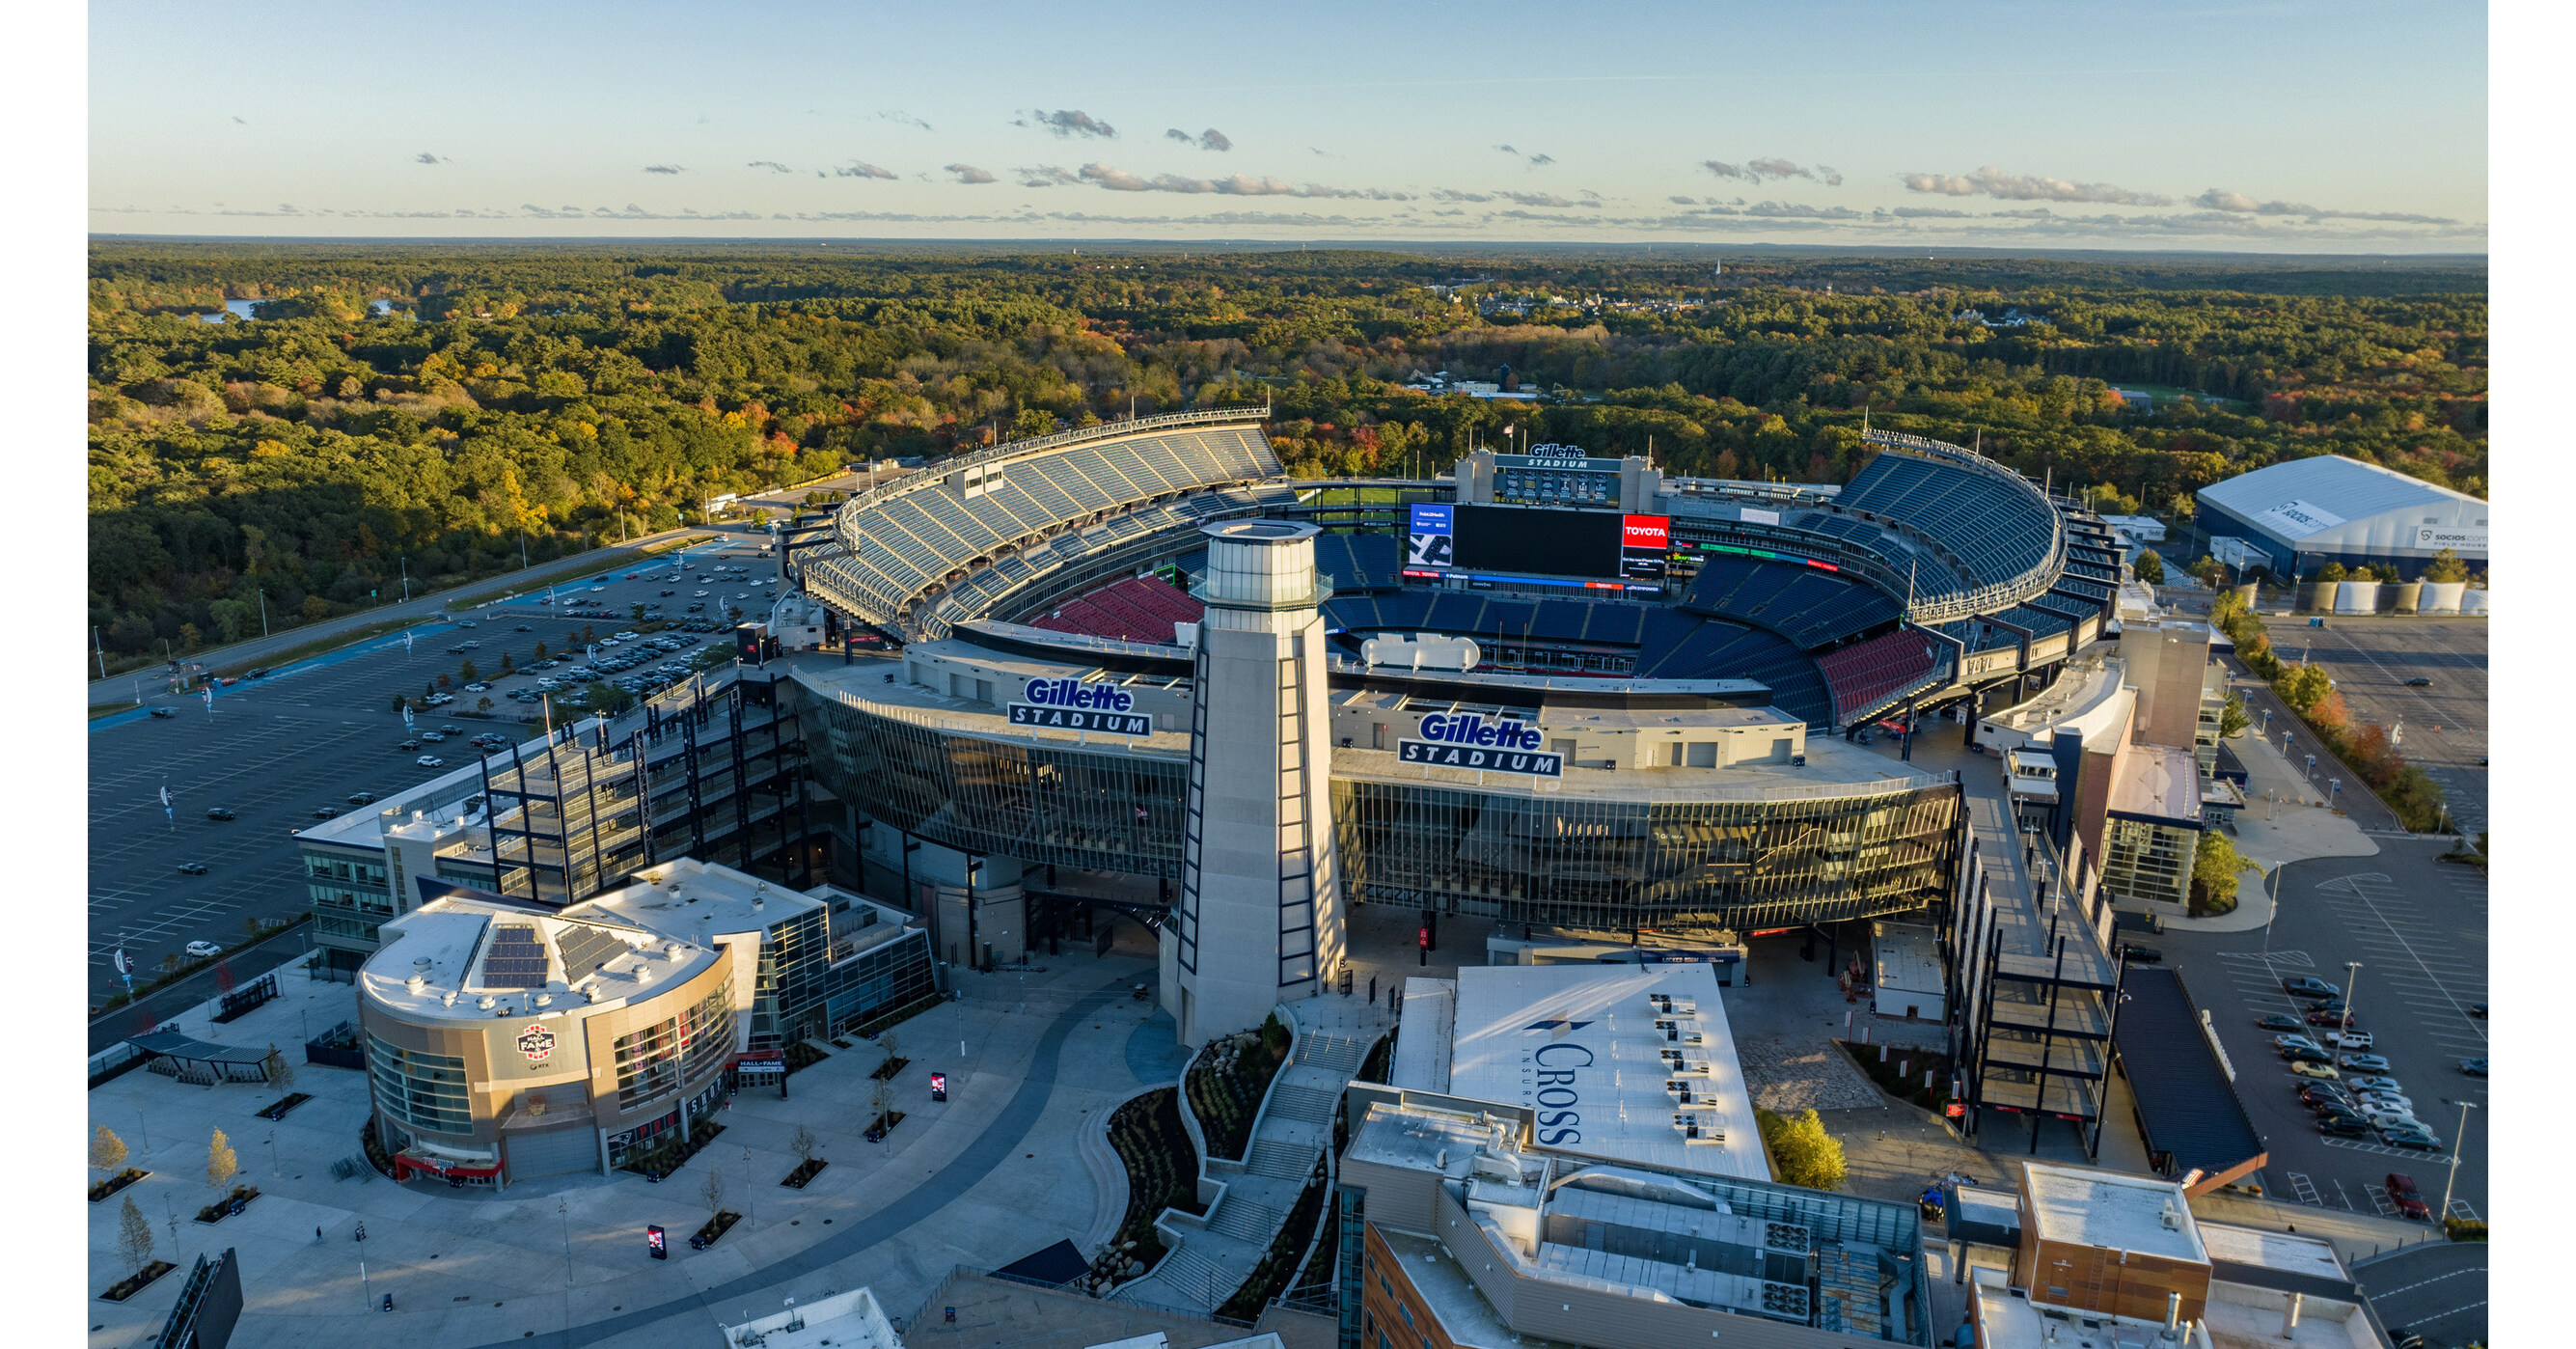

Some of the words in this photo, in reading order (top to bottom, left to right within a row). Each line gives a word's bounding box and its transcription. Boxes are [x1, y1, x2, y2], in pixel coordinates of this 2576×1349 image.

[1528, 459, 1587, 468] STADIUM
[1531, 444, 1585, 458] Gillette
[1626, 527, 1665, 537] TOYOTA
[1026, 677, 1132, 712] Gillette
[1015, 707, 1144, 733] STADIUM
[1420, 713, 1542, 751] Gillette
[1406, 744, 1554, 773] STADIUM
[520, 1039, 553, 1051] FAME
[1521, 1048, 1532, 1107] INSURA
[640, 1113, 675, 1140] PRO
[691, 1077, 723, 1114] SHOP
[1535, 1043, 1594, 1145] CROSS
